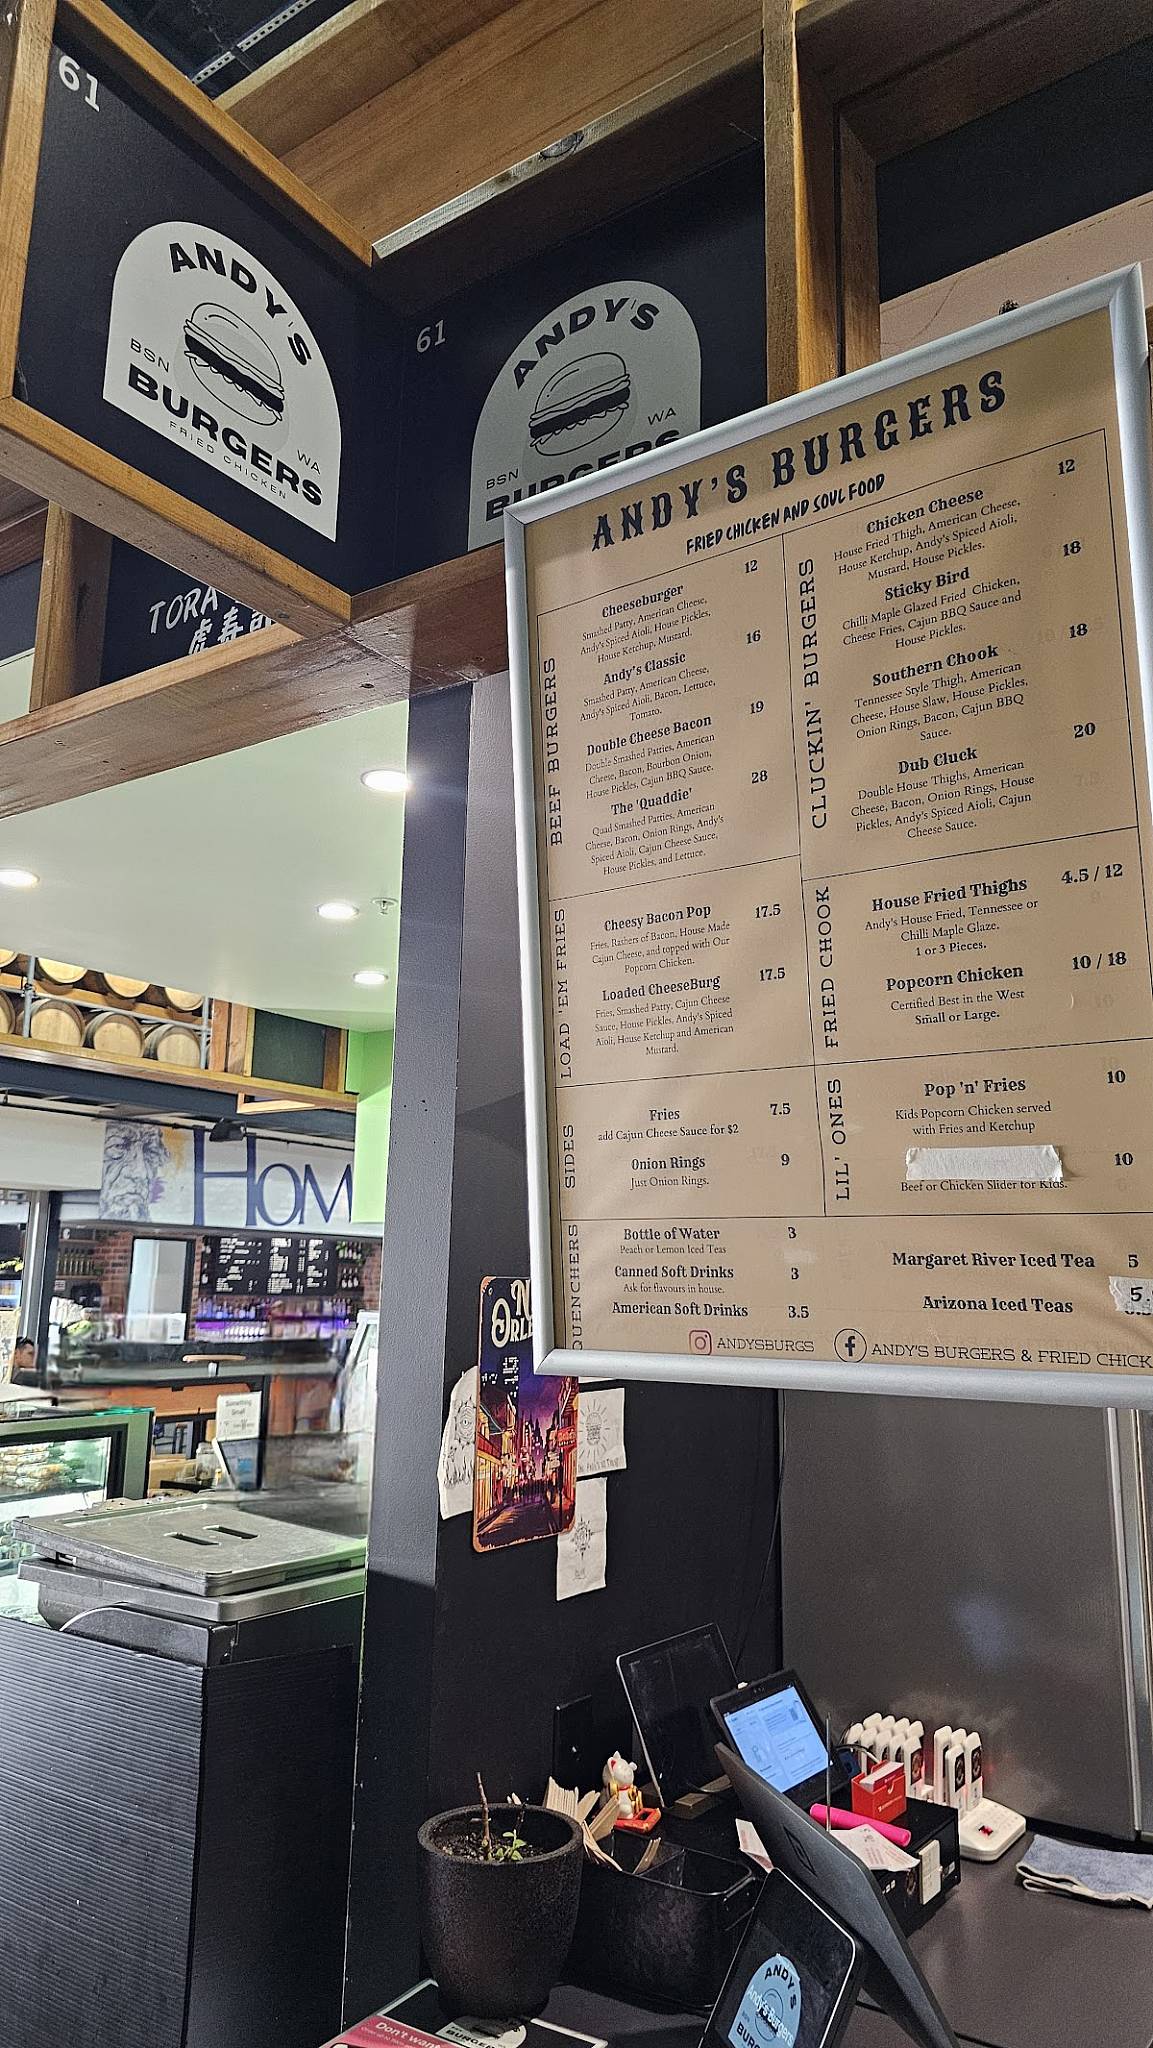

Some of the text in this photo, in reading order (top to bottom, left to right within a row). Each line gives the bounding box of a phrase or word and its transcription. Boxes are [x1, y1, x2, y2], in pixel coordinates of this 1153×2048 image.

[58, 56, 100, 112] 61
[168, 242, 312, 366] ANDY'S
[416, 320, 446, 353] 61
[513, 298, 660, 390] ANDY'S
[130, 337, 169, 373] BSN
[647, 407, 676, 426] WA
[128, 362, 322, 506] BURGERS
[169, 420, 287, 499] FRIED CHICKEN
[297, 449, 321, 475] WA
[591, 370, 1005, 552] ANDY'S BURGERS
[1058, 458, 1075, 475] 12
[486, 468, 519, 490] BSN
[686, 472, 885, 555] FRIED CHICKEN AND SOUL FOOD
[866, 489, 983, 534] Chicken Cheese
[833, 499, 1020, 561] House Fried Thigh, American Cheese,
[1063, 540, 1082, 557] 18
[744, 559, 758, 573] 12
[884, 566, 970, 602] Sticky Bird
[150, 586, 218, 634] TORA
[601, 584, 683, 618] Cheeseburger
[746, 629, 761, 644] 16
[1069, 622, 1088, 638] 18
[603, 651, 686, 685] Andy's Classic
[872, 644, 999, 687] Southern Chook
[798, 558, 827, 829] CLUCKIN' BURGERS
[750, 700, 764, 714] 19
[586, 716, 712, 756] Double Cheese Bacon
[1073, 722, 1096, 739] 20
[543, 657, 562, 846] BEEF BURGERS
[898, 746, 978, 774] Dub Cluck
[751, 769, 768, 784] 28
[610, 787, 692, 815] The 'Quaddie'
[1060, 868, 1089, 884] 4.5
[1104, 863, 1123, 878] 12
[871, 878, 1027, 912] House Fried Thighs
[603, 905, 711, 931] Cheesy Bacon Pop
[755, 903, 781, 918] 17.5
[815, 885, 838, 1048] FRIED CHOOK
[1072, 955, 1091, 970] 10
[1107, 951, 1127, 966] 18
[759, 966, 785, 981] 17.5
[885, 966, 1024, 992] Popcorn Chicken
[554, 908, 572, 1079] LOAD 'EM FRIES
[601, 975, 720, 1001] Loaded CheeseBurg
[890, 989, 1024, 1010] Certified Best in the West
[914, 1010, 1000, 1025] Small or Large.
[1107, 1069, 1126, 1084] 10
[923, 1077, 1026, 1099] Pop 'n' Fries
[648, 1107, 680, 1121] Fries
[769, 1102, 791, 1116] 7.5
[598, 1123, 739, 1142] add Cajun Cheese Sauce for $2
[827, 1078, 850, 1200] LIL' ONES
[562, 1124, 575, 1188] SIDES
[631, 1155, 705, 1171] Onion Rings
[780, 1153, 790, 1166] 9
[1114, 1152, 1133, 1166] 10
[193, 1125, 353, 1227] HOM
[925, 1183, 938, 1191] or
[940, 1180, 984, 1191] Chicken
[987, 1180, 1017, 1190] Slider
[623, 1226, 720, 1240] Bottle of Water
[787, 1226, 797, 1239] 3
[614, 1264, 734, 1278] Canned Soft Drinks
[892, 1251, 1096, 1270] Margaret River Iced Tea
[1128, 1254, 1139, 1268] 5
[791, 1267, 799, 1280] 3
[567, 1224, 583, 1350] QUENCHERS
[611, 1300, 748, 1317] American Soft Drinks
[788, 1305, 809, 1319] 3.5
[922, 1295, 1073, 1313] Arizona Iced Teas
[716, 1337, 814, 1352] ANDYSBURGS
[870, 1343, 929, 1357] ANDY'S
[934, 1345, 1016, 1361] BURGERS
[1020, 1348, 1032, 1362] &
[1037, 1350, 1091, 1365] FRIED
[375, 2022, 408, 2039] Don't
